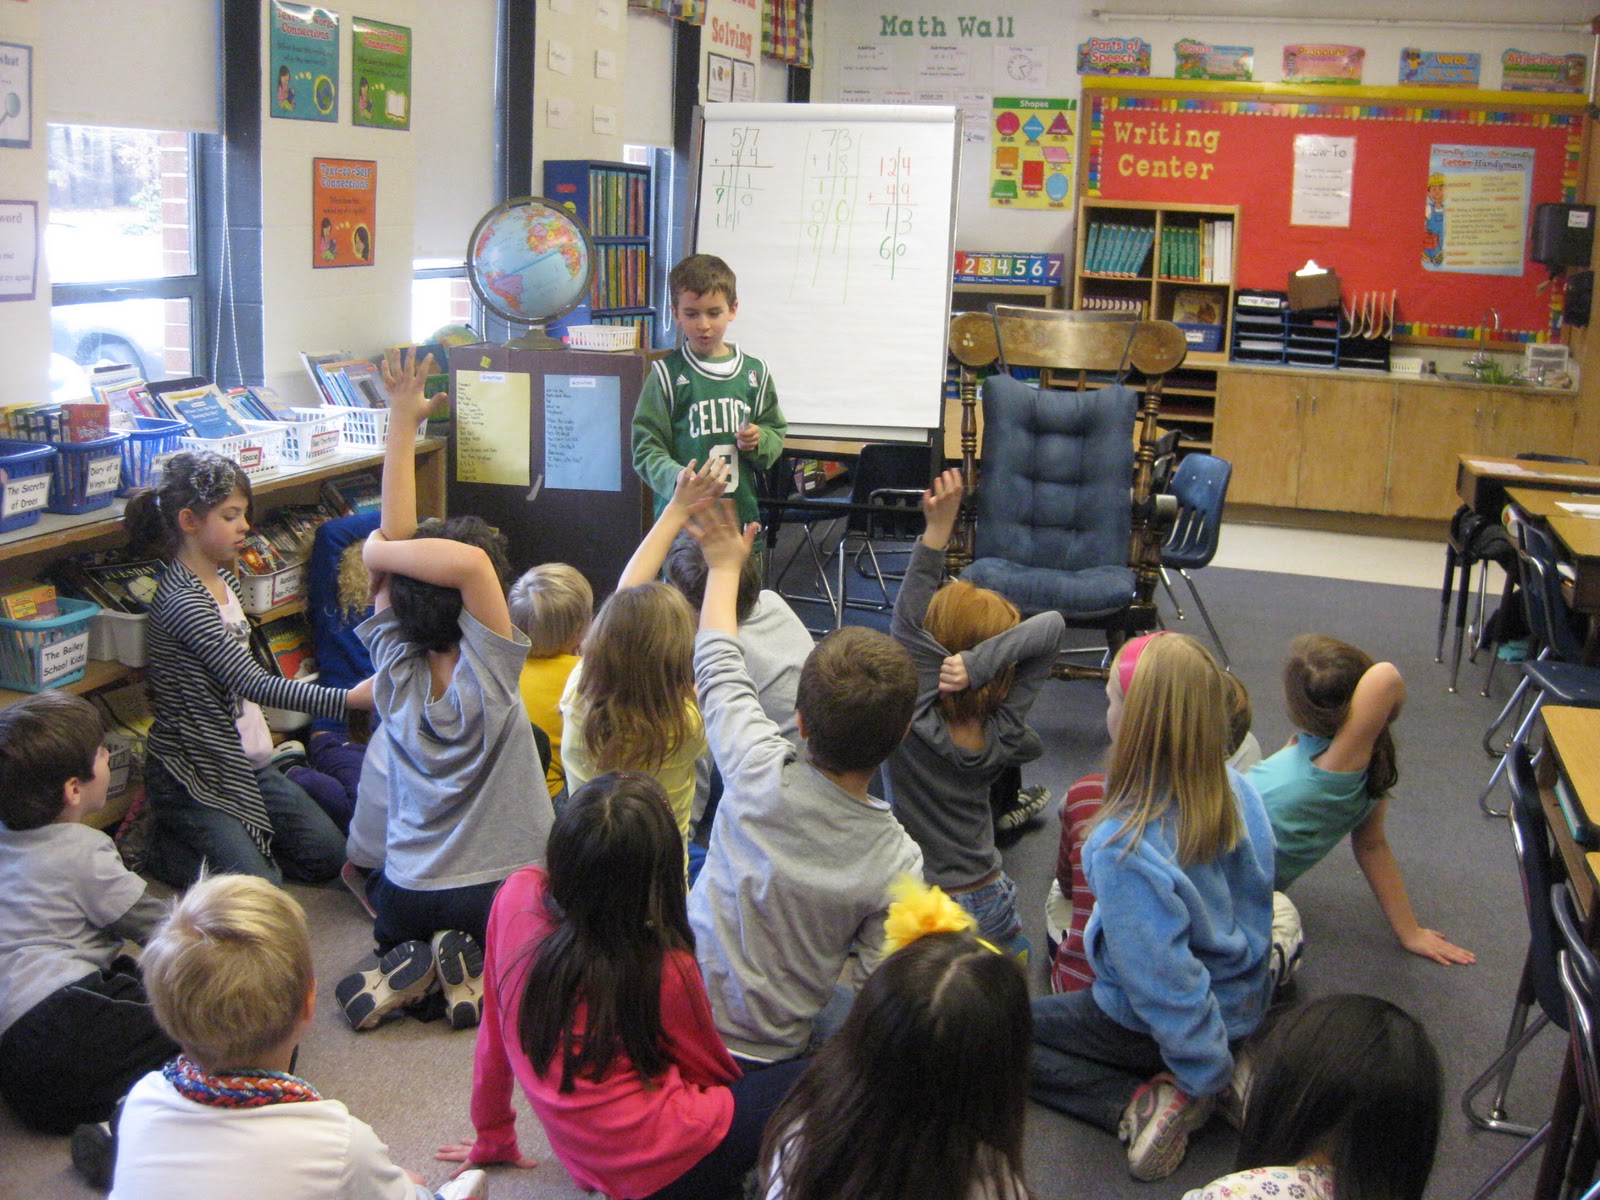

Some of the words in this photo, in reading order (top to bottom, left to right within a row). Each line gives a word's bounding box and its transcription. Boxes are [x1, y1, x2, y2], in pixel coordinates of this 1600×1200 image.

[282, 22, 330, 39] Connections
[880, 15, 946, 37] Math
[957, 16, 1015, 38] Wall
[712, 16, 752, 58] Solving
[1090, 39, 1122, 51] Parts
[1126, 40, 1140, 51] of
[1091, 51, 1137, 64] Speech
[1436, 54, 1469, 65] Verbs
[1506, 53, 1566, 66] Adjectives
[1020, 100, 1049, 109] Shapes
[1113, 121, 1221, 154] Writing
[320, 164, 371, 178] Text-to-Self
[880, 156, 911, 176] 124
[1118, 154, 1214, 180] Center
[1474, 160, 1523, 171] Handyman
[322, 176, 369, 189] Connections
[887, 184, 910, 203] 49
[964, 258, 976, 274] 2
[981, 258, 992, 274] 3
[1014, 260, 1027, 275] 5
[1031, 260, 1043, 276] 6
[1049, 260, 1060, 276] 7
[1260, 298, 1279, 306] Paper
[688, 397, 746, 439] CELTIC
[242, 451, 258, 462] Space
[90, 465, 105, 476] Diary
[106, 463, 114, 472] of
[8, 486, 20, 496] The
[21, 481, 46, 494] Secrets
[89, 481, 106, 490] Wimpy
[11, 501, 19, 510] of
[20, 498, 38, 508] Droon
[104, 565, 157, 580] TUESDAY
[45, 651, 60, 661] The
[63, 641, 85, 655] Bailey
[43, 663, 68, 677] School
[70, 653, 85, 665] Kids
